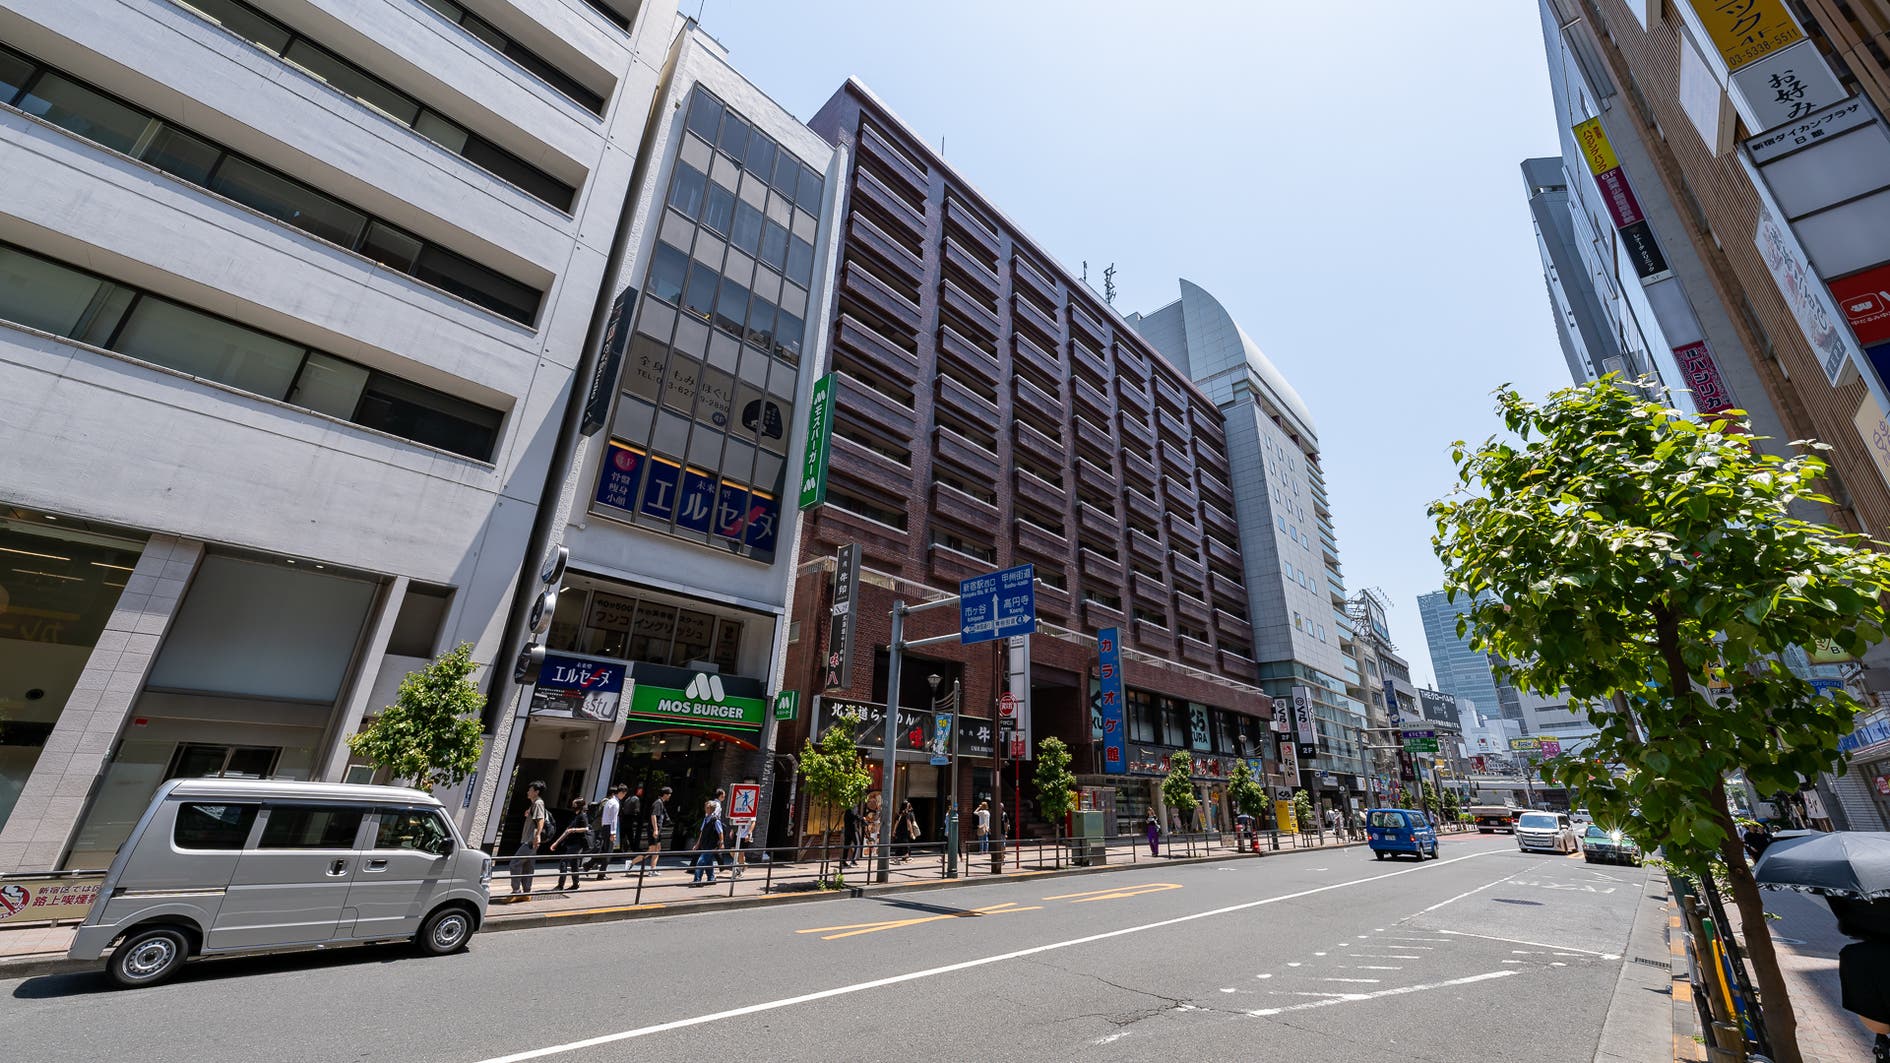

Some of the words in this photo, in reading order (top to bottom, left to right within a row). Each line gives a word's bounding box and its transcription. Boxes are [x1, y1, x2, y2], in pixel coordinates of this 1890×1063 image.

[1729, 28, 1799, 66] 03-5338-5511
[1768, 70, 1816, 119] お好み
[1752, 104, 1859, 151] 新宿ダイカンプラザ
[808, 404, 823, 475] モスバーガー
[1001, 568, 1031, 582] 甲州街道
[1003, 595, 1029, 608] 高円寺
[658, 699, 691, 714] MOS
[693, 703, 744, 719] BURGER
[1101, 639, 1120, 762] カラオケ館
[1192, 732, 1208, 744] URA
